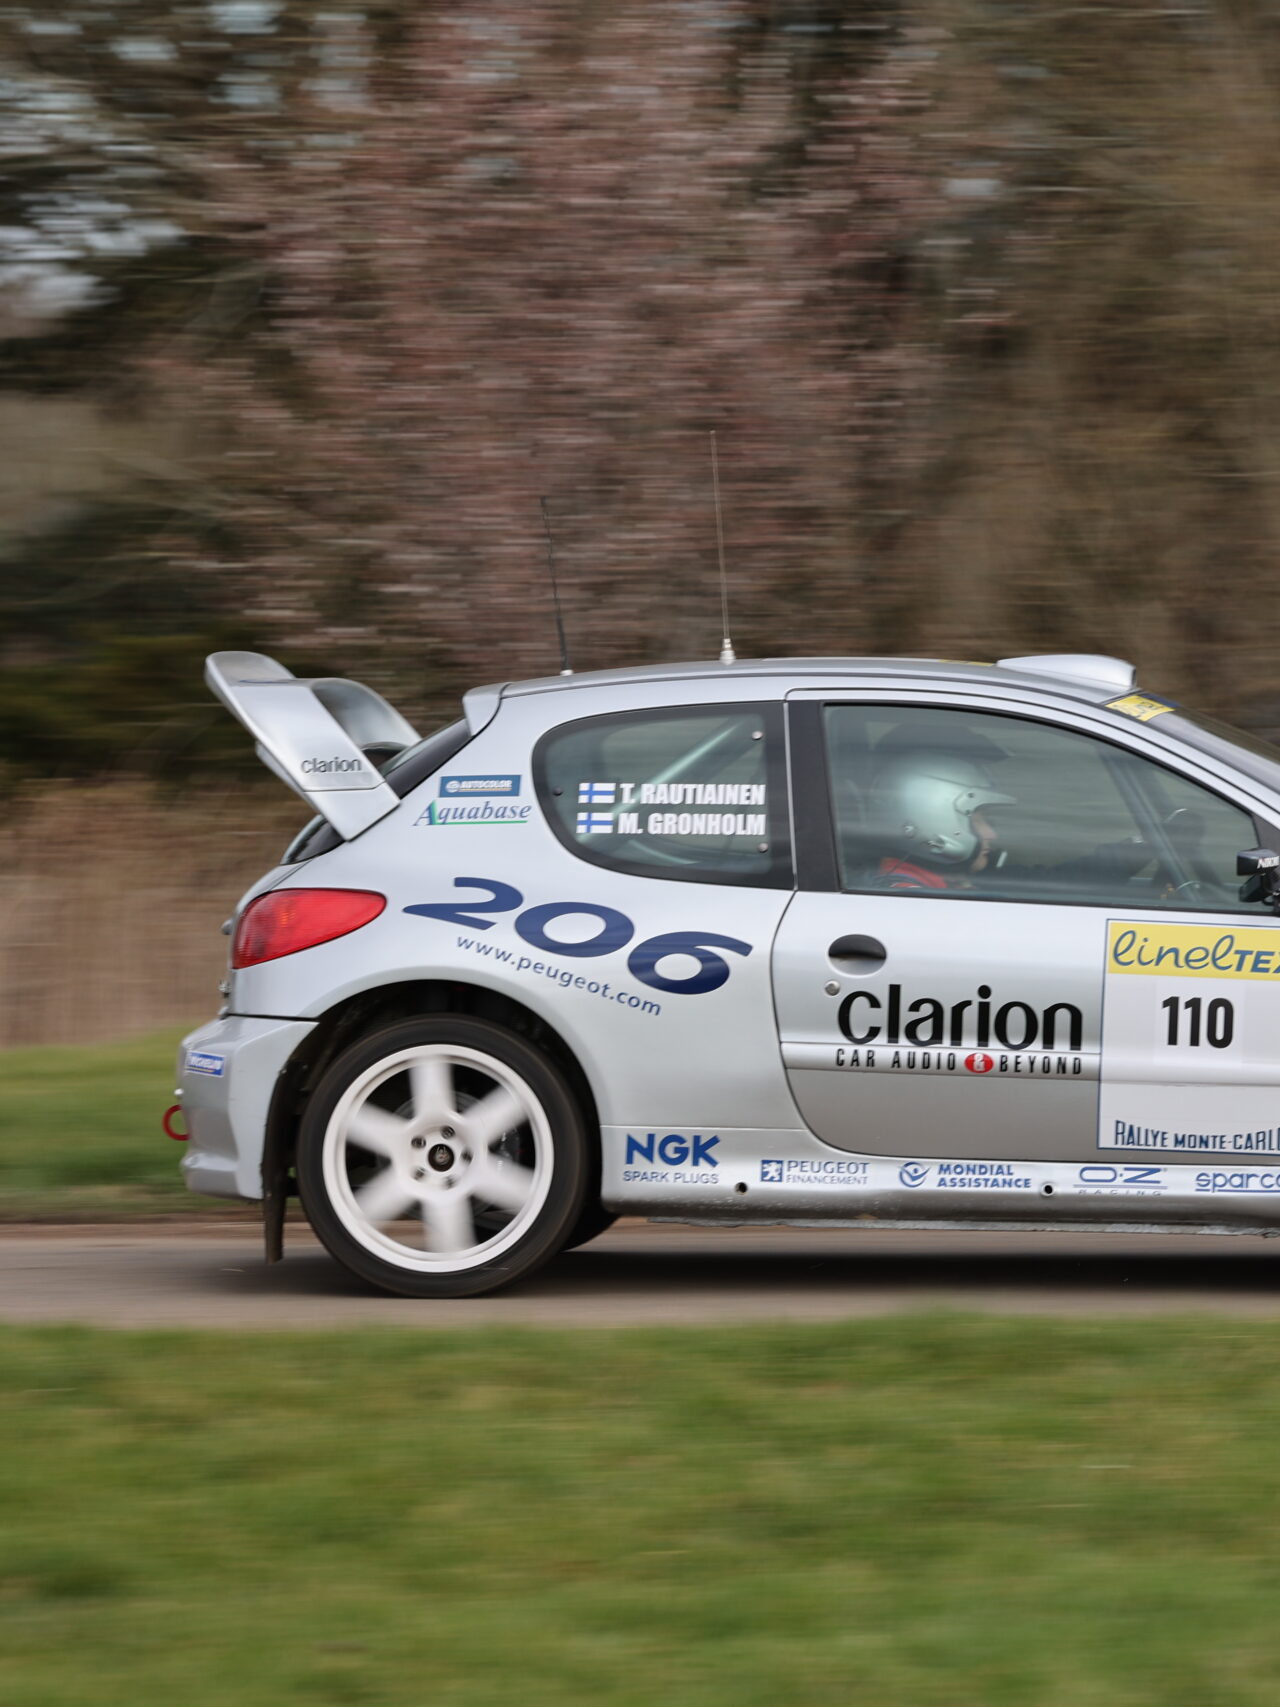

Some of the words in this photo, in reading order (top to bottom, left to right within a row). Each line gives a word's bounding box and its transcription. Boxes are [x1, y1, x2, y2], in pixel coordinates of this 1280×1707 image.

[619, 783, 636, 804] T.
[640, 783, 767, 805] RAUTIAINEN
[411, 800, 532, 826] Aquabase
[617, 812, 643, 834] M.
[647, 812, 767, 836] GRONHOLM
[402, 877, 754, 996] 206
[456, 936, 663, 1016] www.peugeot.com
[837, 984, 1083, 1051] Clarion
[1162, 996, 1234, 1049] 110
[836, 1049, 875, 1068] CAR
[891, 1051, 956, 1071] AUDIO
[999, 1054, 1082, 1075] BEYOND
[1114, 1120, 1168, 1148] RALLYE
[625, 1133, 721, 1168] NGK
[623, 1170, 670, 1182] SPARK
[673, 1172, 719, 1184] PLUGS
[785, 1174, 868, 1185] FINANCEMENT
[787, 1160, 870, 1174] PEUGEOT
[938, 1164, 1014, 1176] MONDIAL
[937, 1178, 1032, 1188] ASSISTANCE
